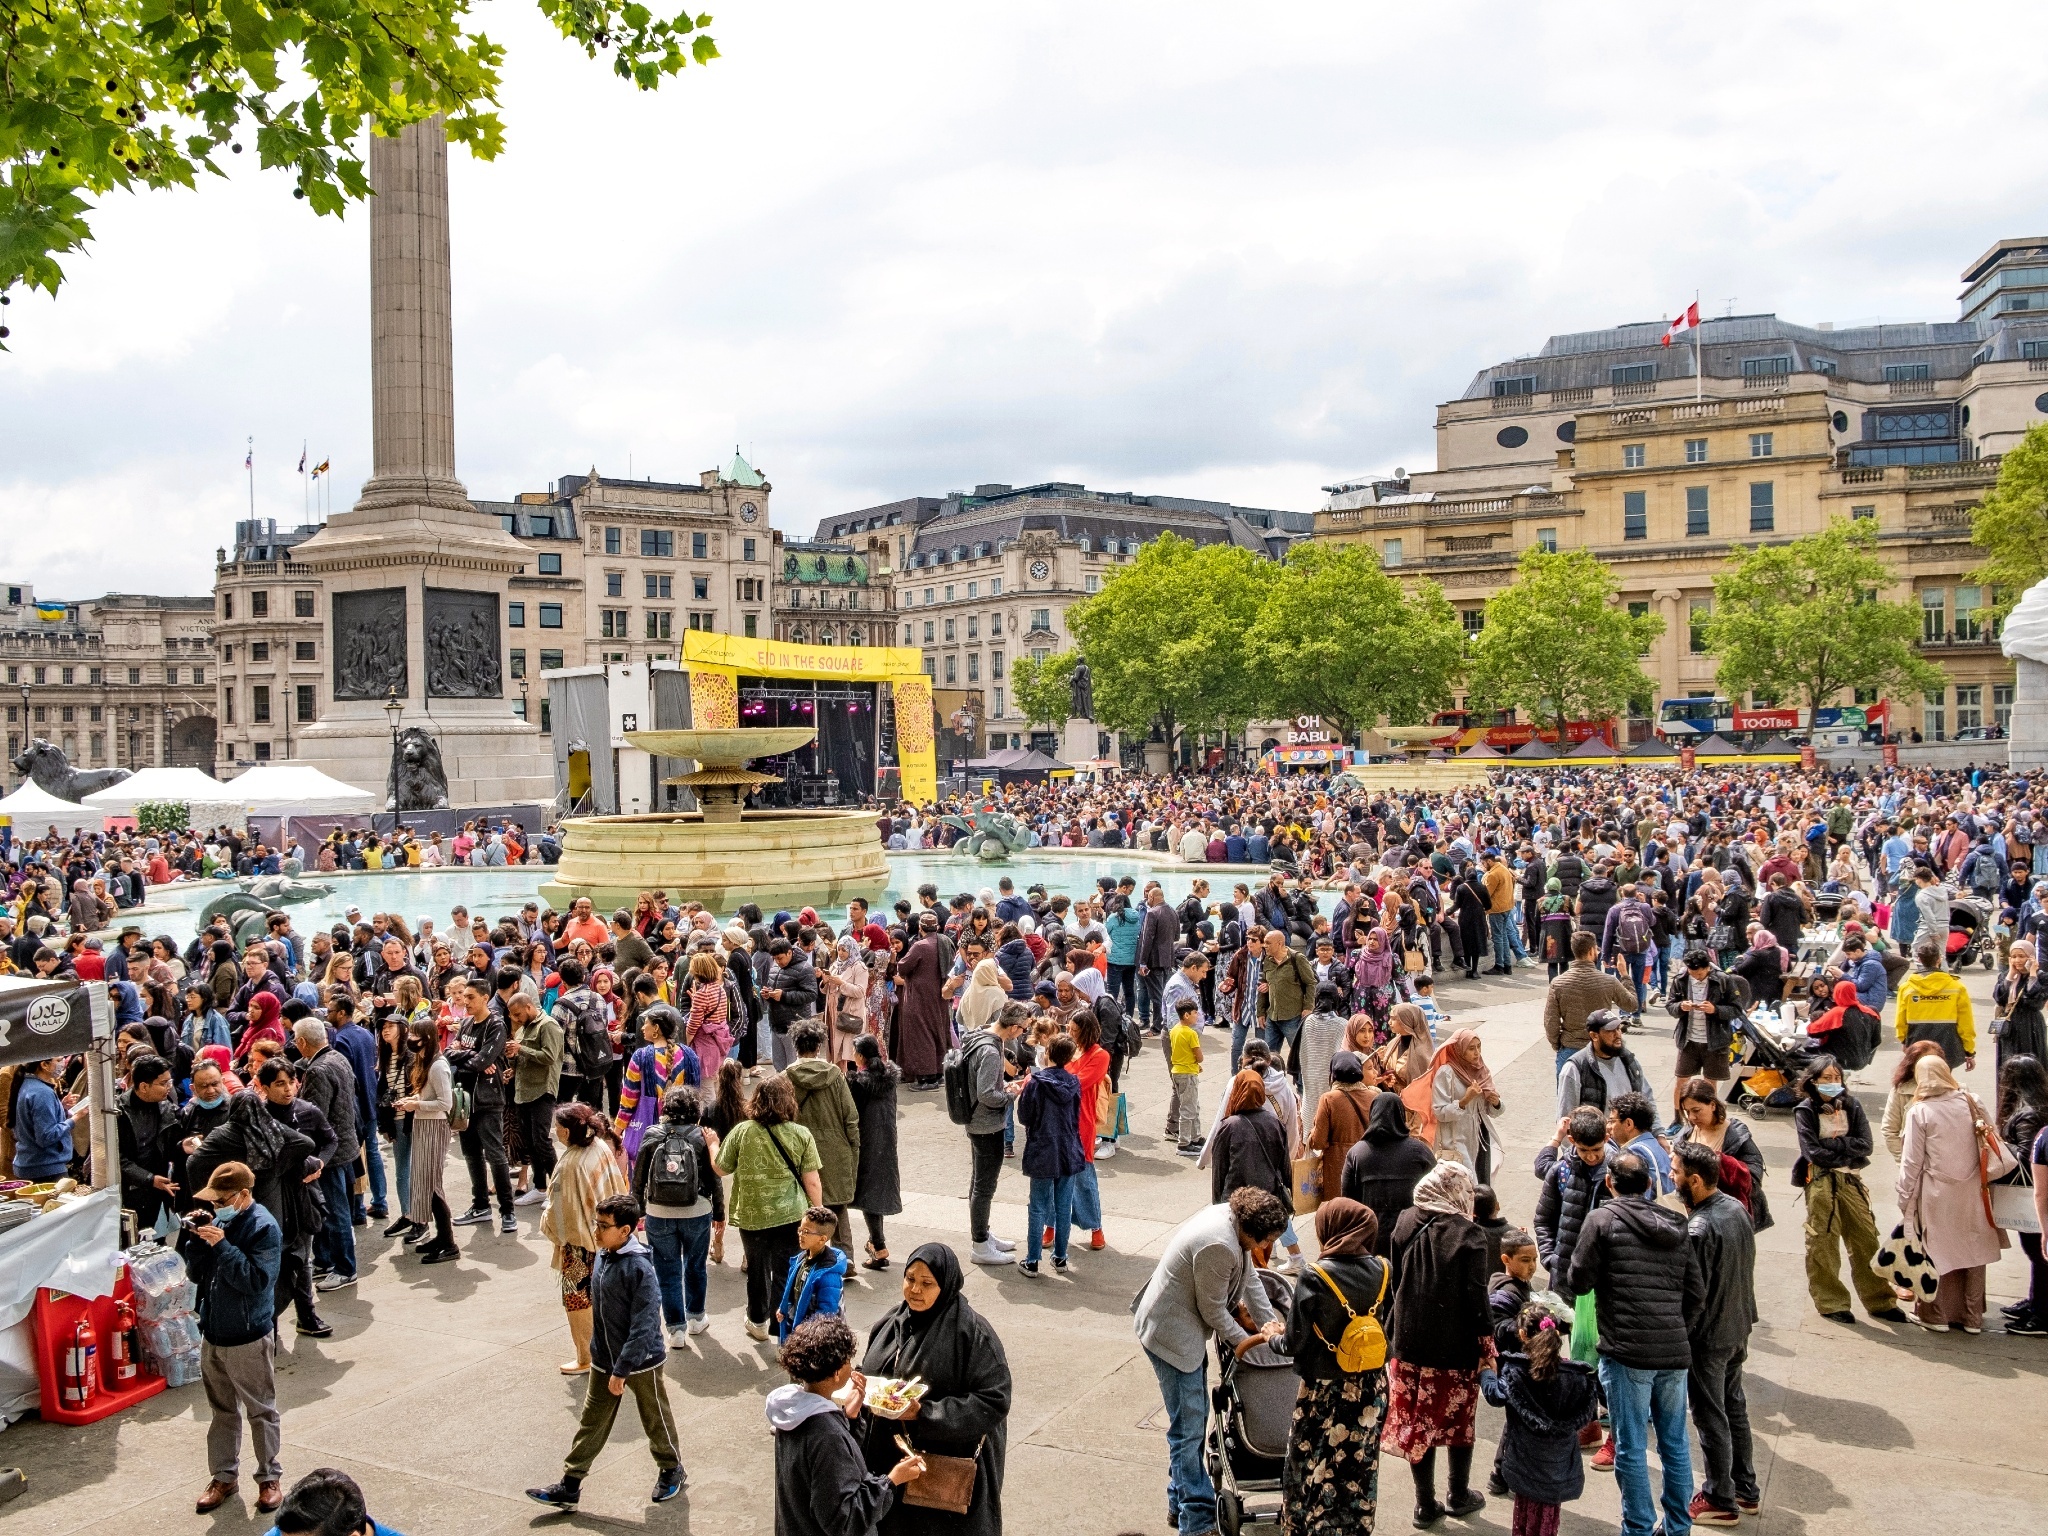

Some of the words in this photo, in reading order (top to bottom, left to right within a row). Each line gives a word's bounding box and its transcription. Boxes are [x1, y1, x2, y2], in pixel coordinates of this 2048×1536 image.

[603, 489, 665, 506] CANADIAN
[667, 495, 710, 509] PACIFIC
[758, 651, 776, 665] EID
[779, 652, 790, 667] IN
[794, 655, 814, 669] THE
[818, 656, 863, 670] SQUARE
[1298, 715, 1319, 728] OH
[1288, 731, 1330, 742] BABU
[32, 1003, 65, 1020] حلال
[35, 1018, 63, 1028] HALAL
